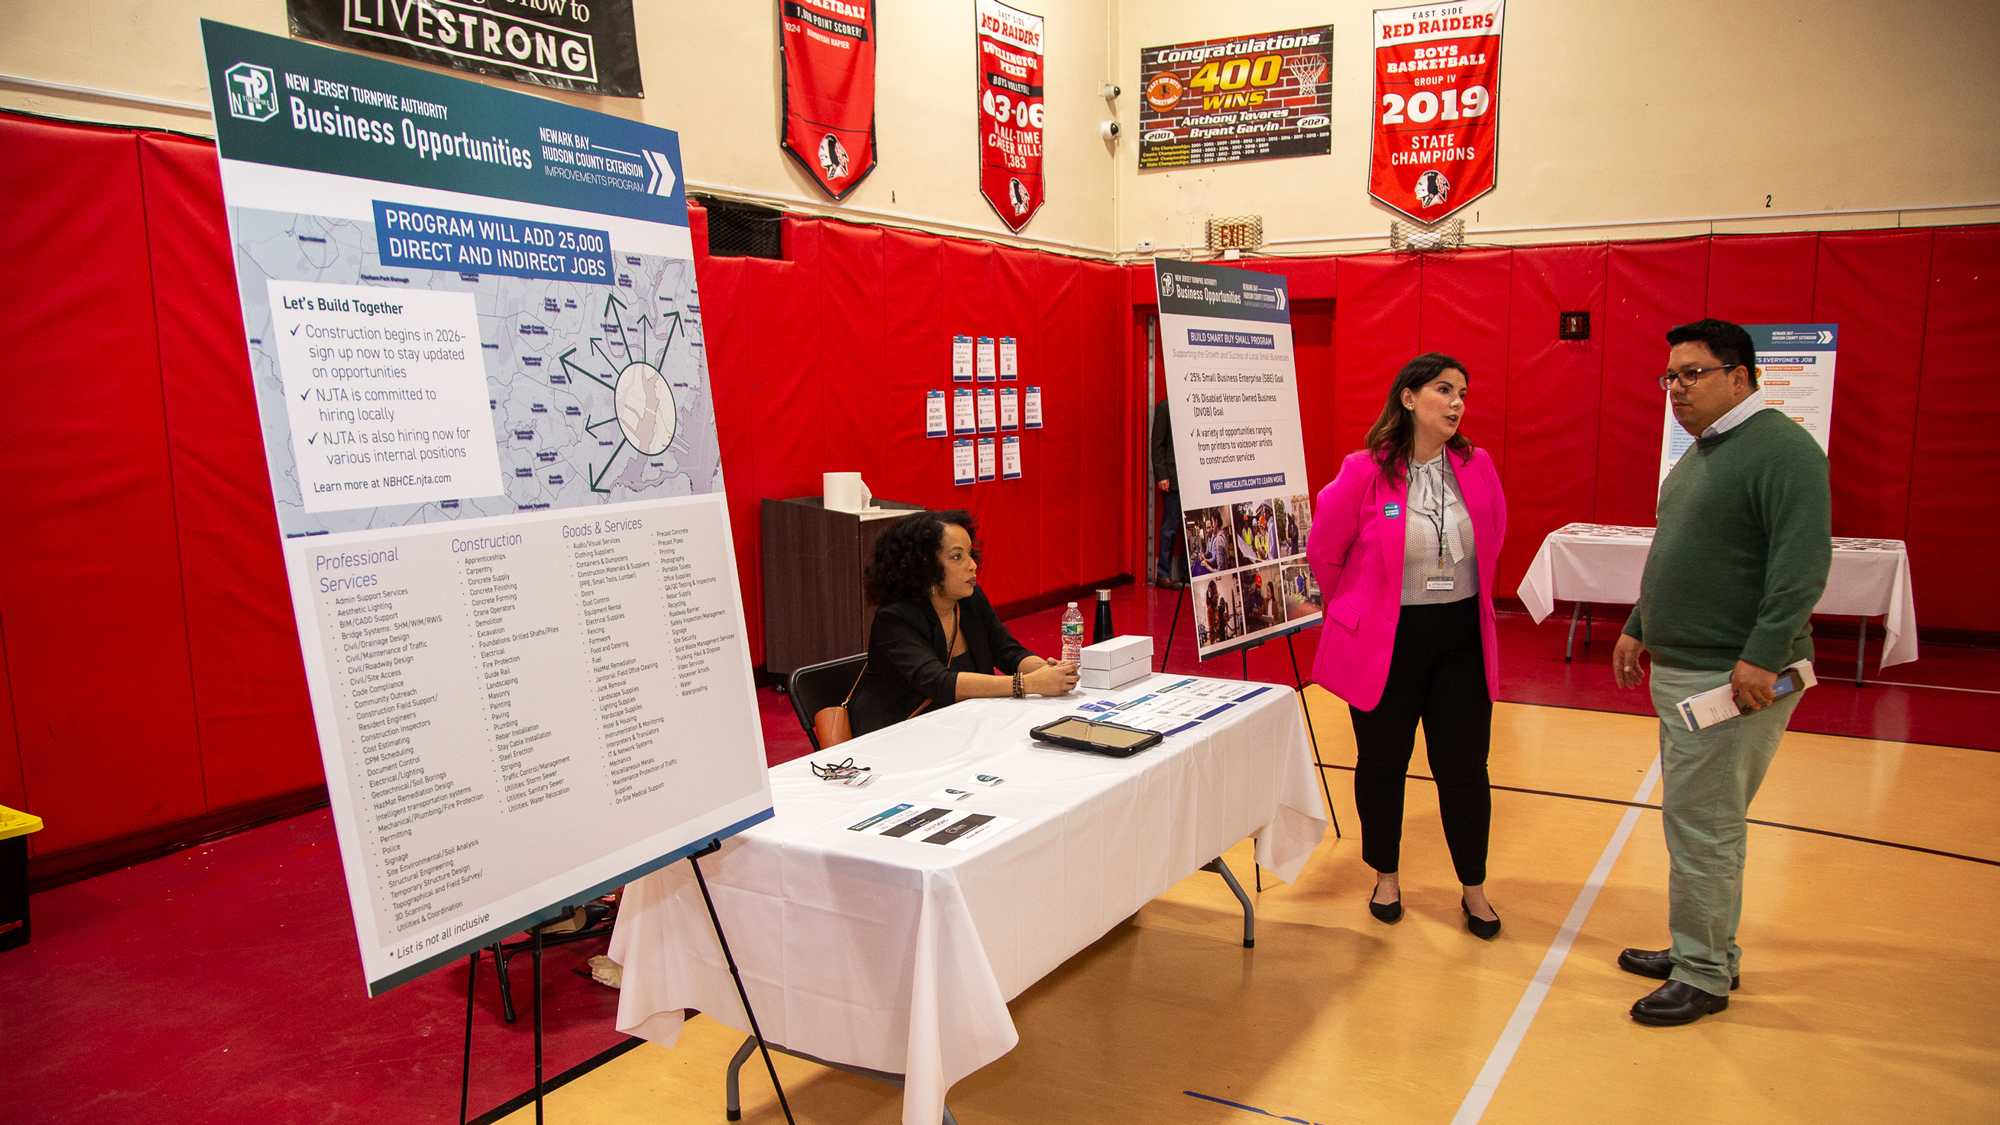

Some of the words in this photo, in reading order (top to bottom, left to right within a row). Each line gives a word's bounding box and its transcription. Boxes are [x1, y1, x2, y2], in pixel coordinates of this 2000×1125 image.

[570, 0, 590, 22] to
[998, 10, 1011, 21] EAST
[1013, 15, 1025, 27] SIDE
[1413, 10, 1436, 19] EAST
[1441, 7, 1463, 16] SIDE
[813, 15, 832, 30] POINT
[834, 22, 862, 38] SCORERS
[1002, 22, 1040, 46] RAIDERS
[1382, 23, 1414, 40] RED
[1419, 13, 1493, 34] RAIDERS
[355, 0, 588, 72] LIVESTRONG
[1157, 34, 1321, 64] Congratulations
[1414, 45, 1458, 59] BOYS
[1000, 60, 1027, 78] PEREZ
[1387, 54, 1486, 73] BASKETBALL
[1189, 55, 1283, 92] 400
[1414, 76, 1444, 86] GROUP
[1447, 75, 1456, 83] IV
[993, 75, 1008, 86] BOYS
[1008, 80, 1030, 96] VOLLEYBALL
[285, 72, 309, 92] NEW
[313, 78, 349, 100] JERSEY
[351, 86, 399, 110] TURNPIKE
[401, 97, 447, 120] AUTHORITY
[1203, 91, 1266, 110] WINS
[1382, 85, 1489, 125] 2019
[1181, 115, 1236, 127] Anthony
[1239, 109, 1289, 122] Tavares
[1301, 118, 1325, 126] 2021
[290, 96, 395, 146] Business
[401, 118, 532, 170] Opportunities
[540, 126, 573, 147] NEWARK
[574, 135, 589, 150] BAY
[1001, 124, 1040, 144] ALL-TIME
[1148, 132, 1171, 140] 2001
[1189, 127, 1235, 139] Bryant
[1237, 122, 1280, 134] Garvin
[1411, 134, 1455, 149] STATE
[542, 146, 574, 165] HUDSON
[576, 153, 604, 171] COUNTY
[606, 160, 644, 178] EXTENSION
[1003, 153, 1026, 168] 1,383
[1391, 147, 1475, 165] CHAMPIONS
[545, 165, 607, 186] IMPROVEMENTS
[607, 175, 644, 192] PROGRAM
[1765, 194, 1772, 208] 2
[385, 208, 475, 237] PROGRAM
[478, 220, 520, 243] WILL
[524, 227, 554, 248] ADD
[558, 230, 604, 254] 25,000
[1221, 225, 1247, 247] EXIT
[390, 237, 452, 262] DIRECT
[458, 245, 492, 266] AND
[497, 248, 565, 273] INDIRECT
[570, 257, 606, 277] JOBS
[1176, 283, 1203, 301] Business
[1204, 287, 1241, 305] Opportunities
[283, 296, 314, 310] Let's
[318, 298, 349, 312] Build
[352, 300, 403, 316] Together
[306, 324, 382, 341] Construction
[384, 327, 421, 343] begins
[424, 328, 433, 341] in
[1190, 332, 1206, 341] BUILD
[1207, 333, 1224, 343] SMART
[1225, 334, 1234, 343] BUY
[1235, 335, 1251, 344] SMALL
[1251, 336, 1272, 345] PROGRAM
[309, 345, 335, 361] sign
[339, 347, 353, 361] up
[357, 348, 380, 359] now
[384, 349, 394, 359] to
[398, 348, 419, 362] stay
[423, 348, 465, 362] updated
[312, 366, 327, 378] on
[331, 365, 407, 381] opportunities
[1190, 373, 1201, 382] 25%
[1202, 373, 1216, 382] Small
[1217, 373, 1238, 382] Business
[1239, 373, 1262, 384] Enterprise
[1262, 373, 1274, 383] (SBE)
[1275, 374, 1284, 383] Goal
[316, 388, 349, 401] NJTA
[351, 388, 361, 401] is
[365, 388, 423, 401] committed
[426, 389, 436, 400] to
[1192, 394, 1200, 403] 3%
[1201, 394, 1222, 403] Disabled
[1223, 394, 1241, 402] Veteran
[1242, 393, 1257, 402] Owned
[1258, 393, 1276, 402] Business
[319, 408, 354, 424] hiring
[358, 407, 395, 422] locally
[323, 431, 356, 445] NJTA
[359, 430, 368, 443] is
[372, 430, 395, 443] also
[398, 429, 429, 443] hiring
[432, 429, 454, 440] now
[457, 427, 470, 439] for
[326, 450, 371, 465] various
[374, 448, 417, 462] internal
[420, 445, 466, 462] positions
[313, 482, 342, 493] Learn
[344, 478, 368, 490] more
[371, 479, 380, 488] at
[383, 473, 451, 487] NBHCE.njta.com
[562, 523, 592, 538] Goods
[595, 521, 602, 534] &
[605, 518, 642, 533] Services
[452, 533, 522, 553] Construction
[316, 546, 398, 571] Professional
[465, 553, 506, 565] Apprenticeships
[661, 556, 685, 564] Photography
[466, 566, 492, 575] Carpentry
[320, 573, 378, 593] Services
[336, 596, 355, 605] Admin
[357, 592, 381, 602] Support
[383, 588, 408, 597] Services
[475, 617, 503, 627] Demolition
[587, 627, 605, 635] Fencing
[477, 627, 505, 638] Excavation
[481, 648, 505, 658] Electrical
[486, 678, 518, 690] Landscaping
[488, 690, 510, 700] Masonry
[490, 700, 511, 710] Painting
[492, 711, 509, 720] Paving
[493, 720, 518, 731] Plumbing
[380, 829, 412, 843] Permitting
[382, 844, 400, 854] Police
[384, 853, 408, 866] Signage
[397, 945, 414, 959] List
[416, 941, 423, 951] is
[425, 934, 439, 947] not
[441, 927, 452, 940] all
[454, 913, 490, 935] inclusive
